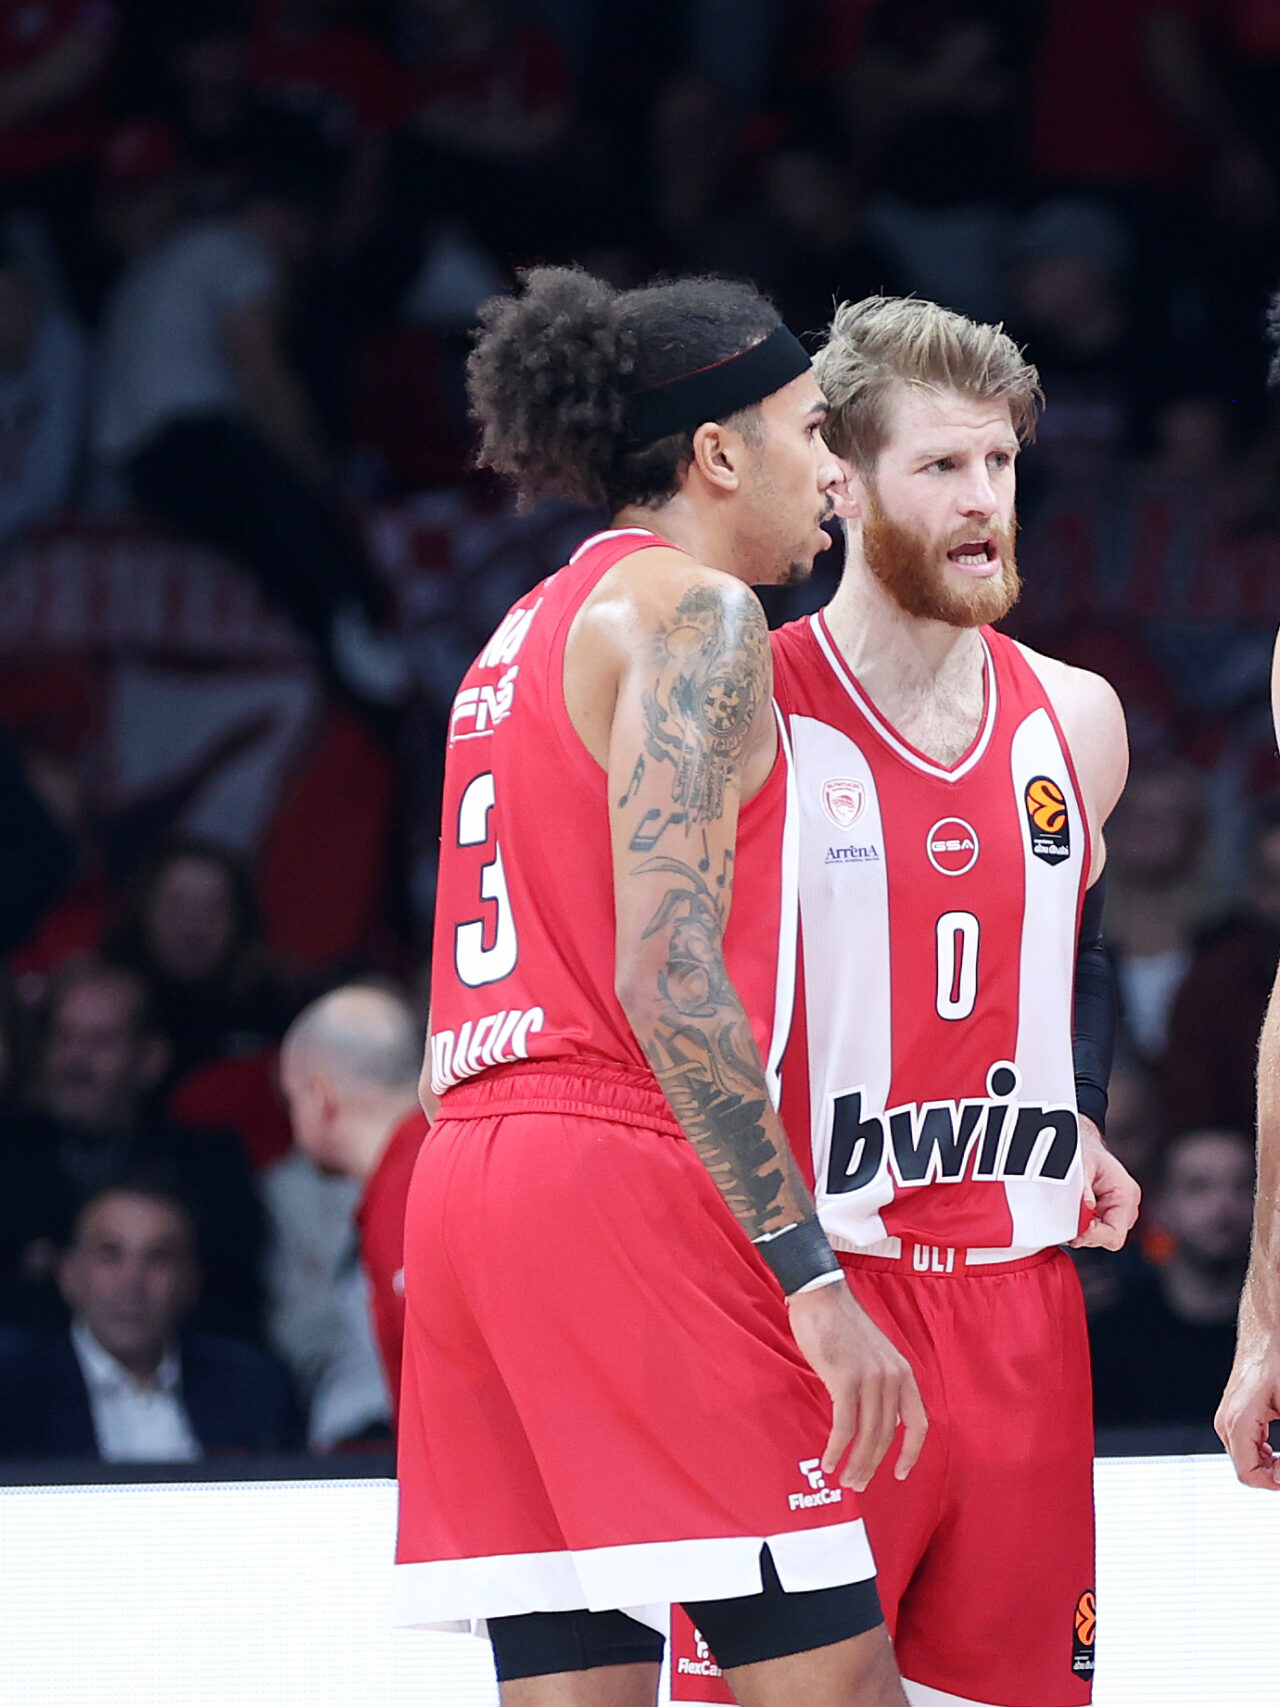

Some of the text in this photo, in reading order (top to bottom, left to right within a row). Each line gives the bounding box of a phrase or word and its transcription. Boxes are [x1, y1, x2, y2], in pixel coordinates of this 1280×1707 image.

[454, 771, 518, 989] 3
[931, 838, 975, 852] GSA
[935, 910, 981, 1021] 0
[823, 1063, 1078, 1197] bwin
[787, 1488, 842, 1511] FlexCar
